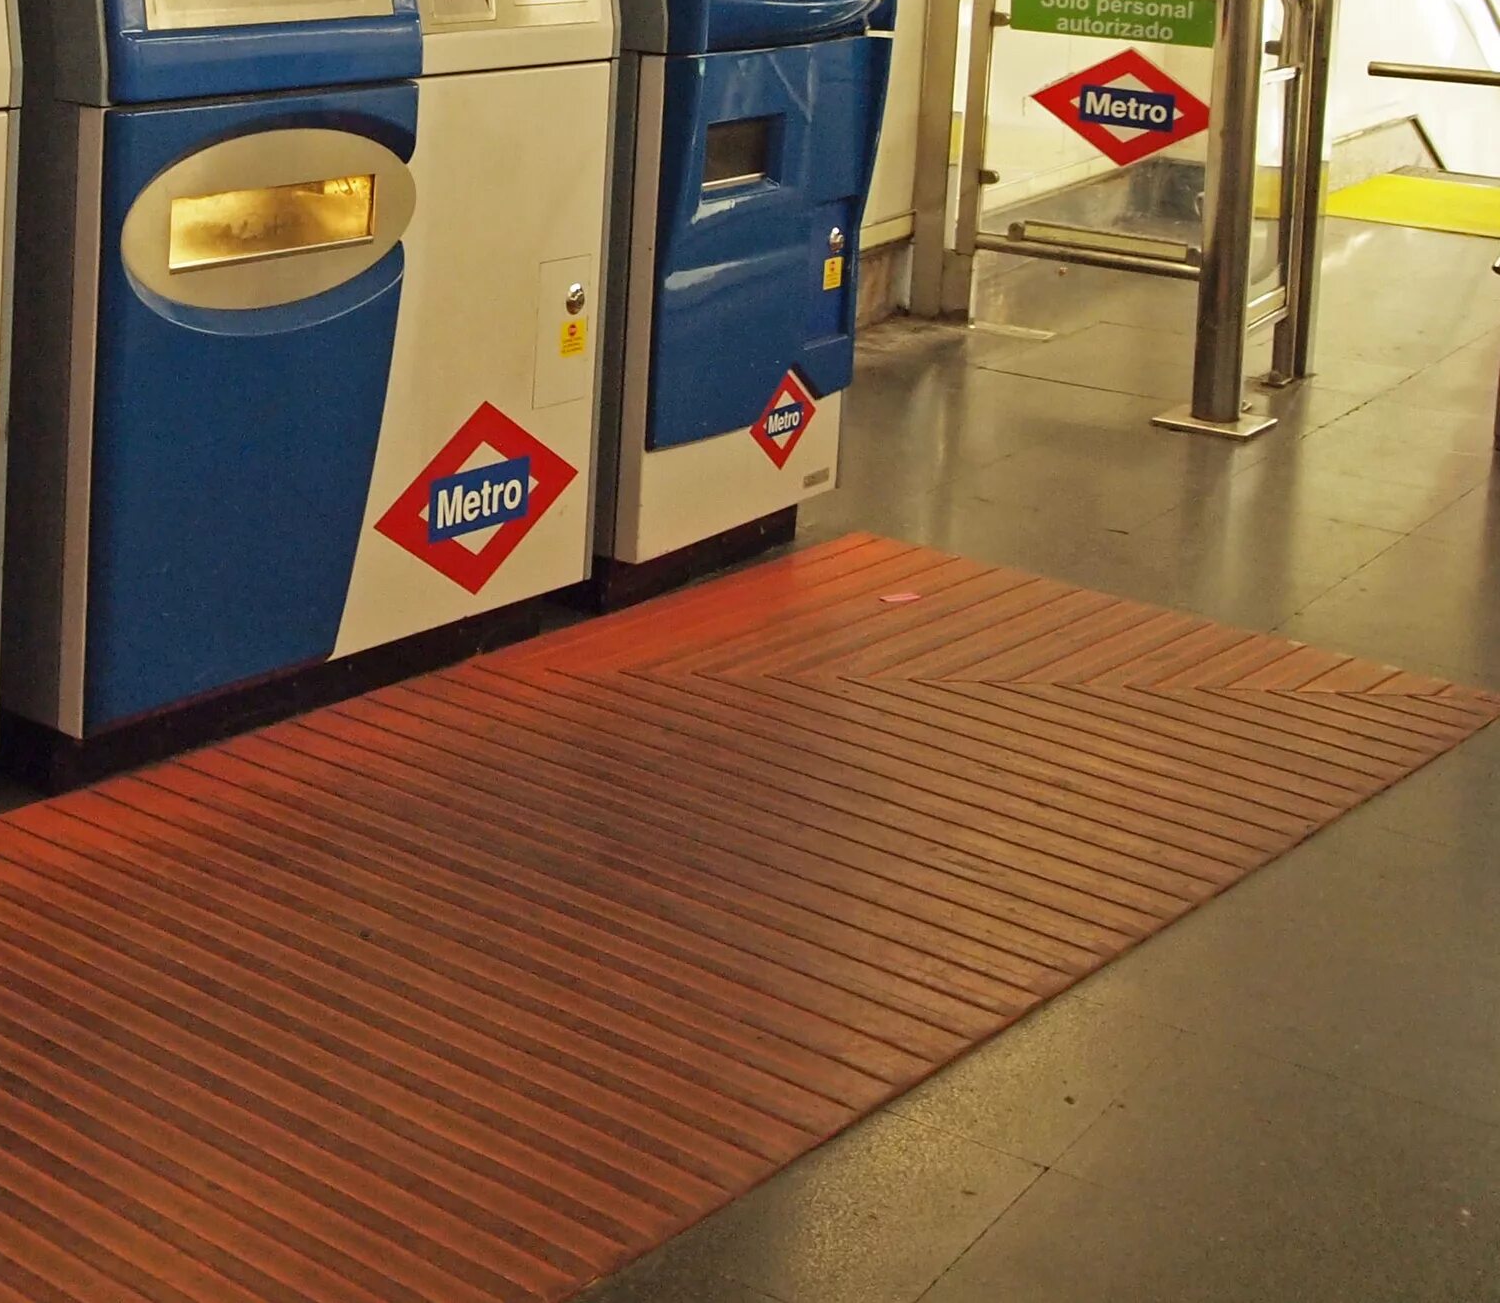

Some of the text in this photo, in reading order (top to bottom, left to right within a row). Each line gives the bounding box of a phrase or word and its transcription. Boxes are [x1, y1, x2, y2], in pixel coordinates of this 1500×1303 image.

[1056, 16, 1173, 41] autorizado
[1085, 90, 1167, 123] Metro
[768, 409, 800, 434] Metro
[436, 479, 522, 529] Metro
